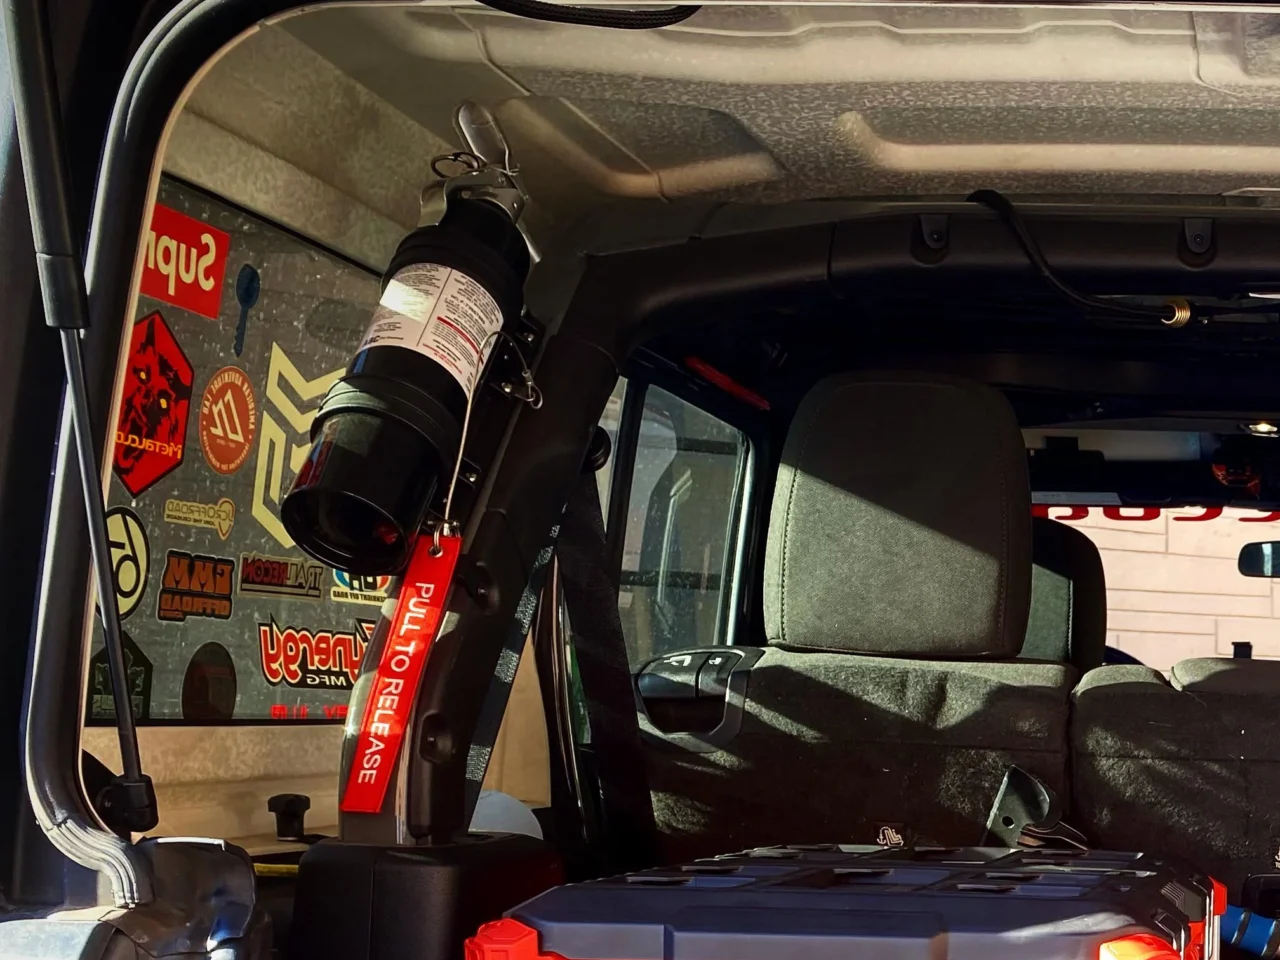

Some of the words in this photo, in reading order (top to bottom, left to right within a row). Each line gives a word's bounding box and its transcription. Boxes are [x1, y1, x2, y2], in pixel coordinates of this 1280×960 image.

[399, 581, 435, 637] PULL
[390, 640, 416, 673] TO
[358, 677, 404, 785] RELEASE
